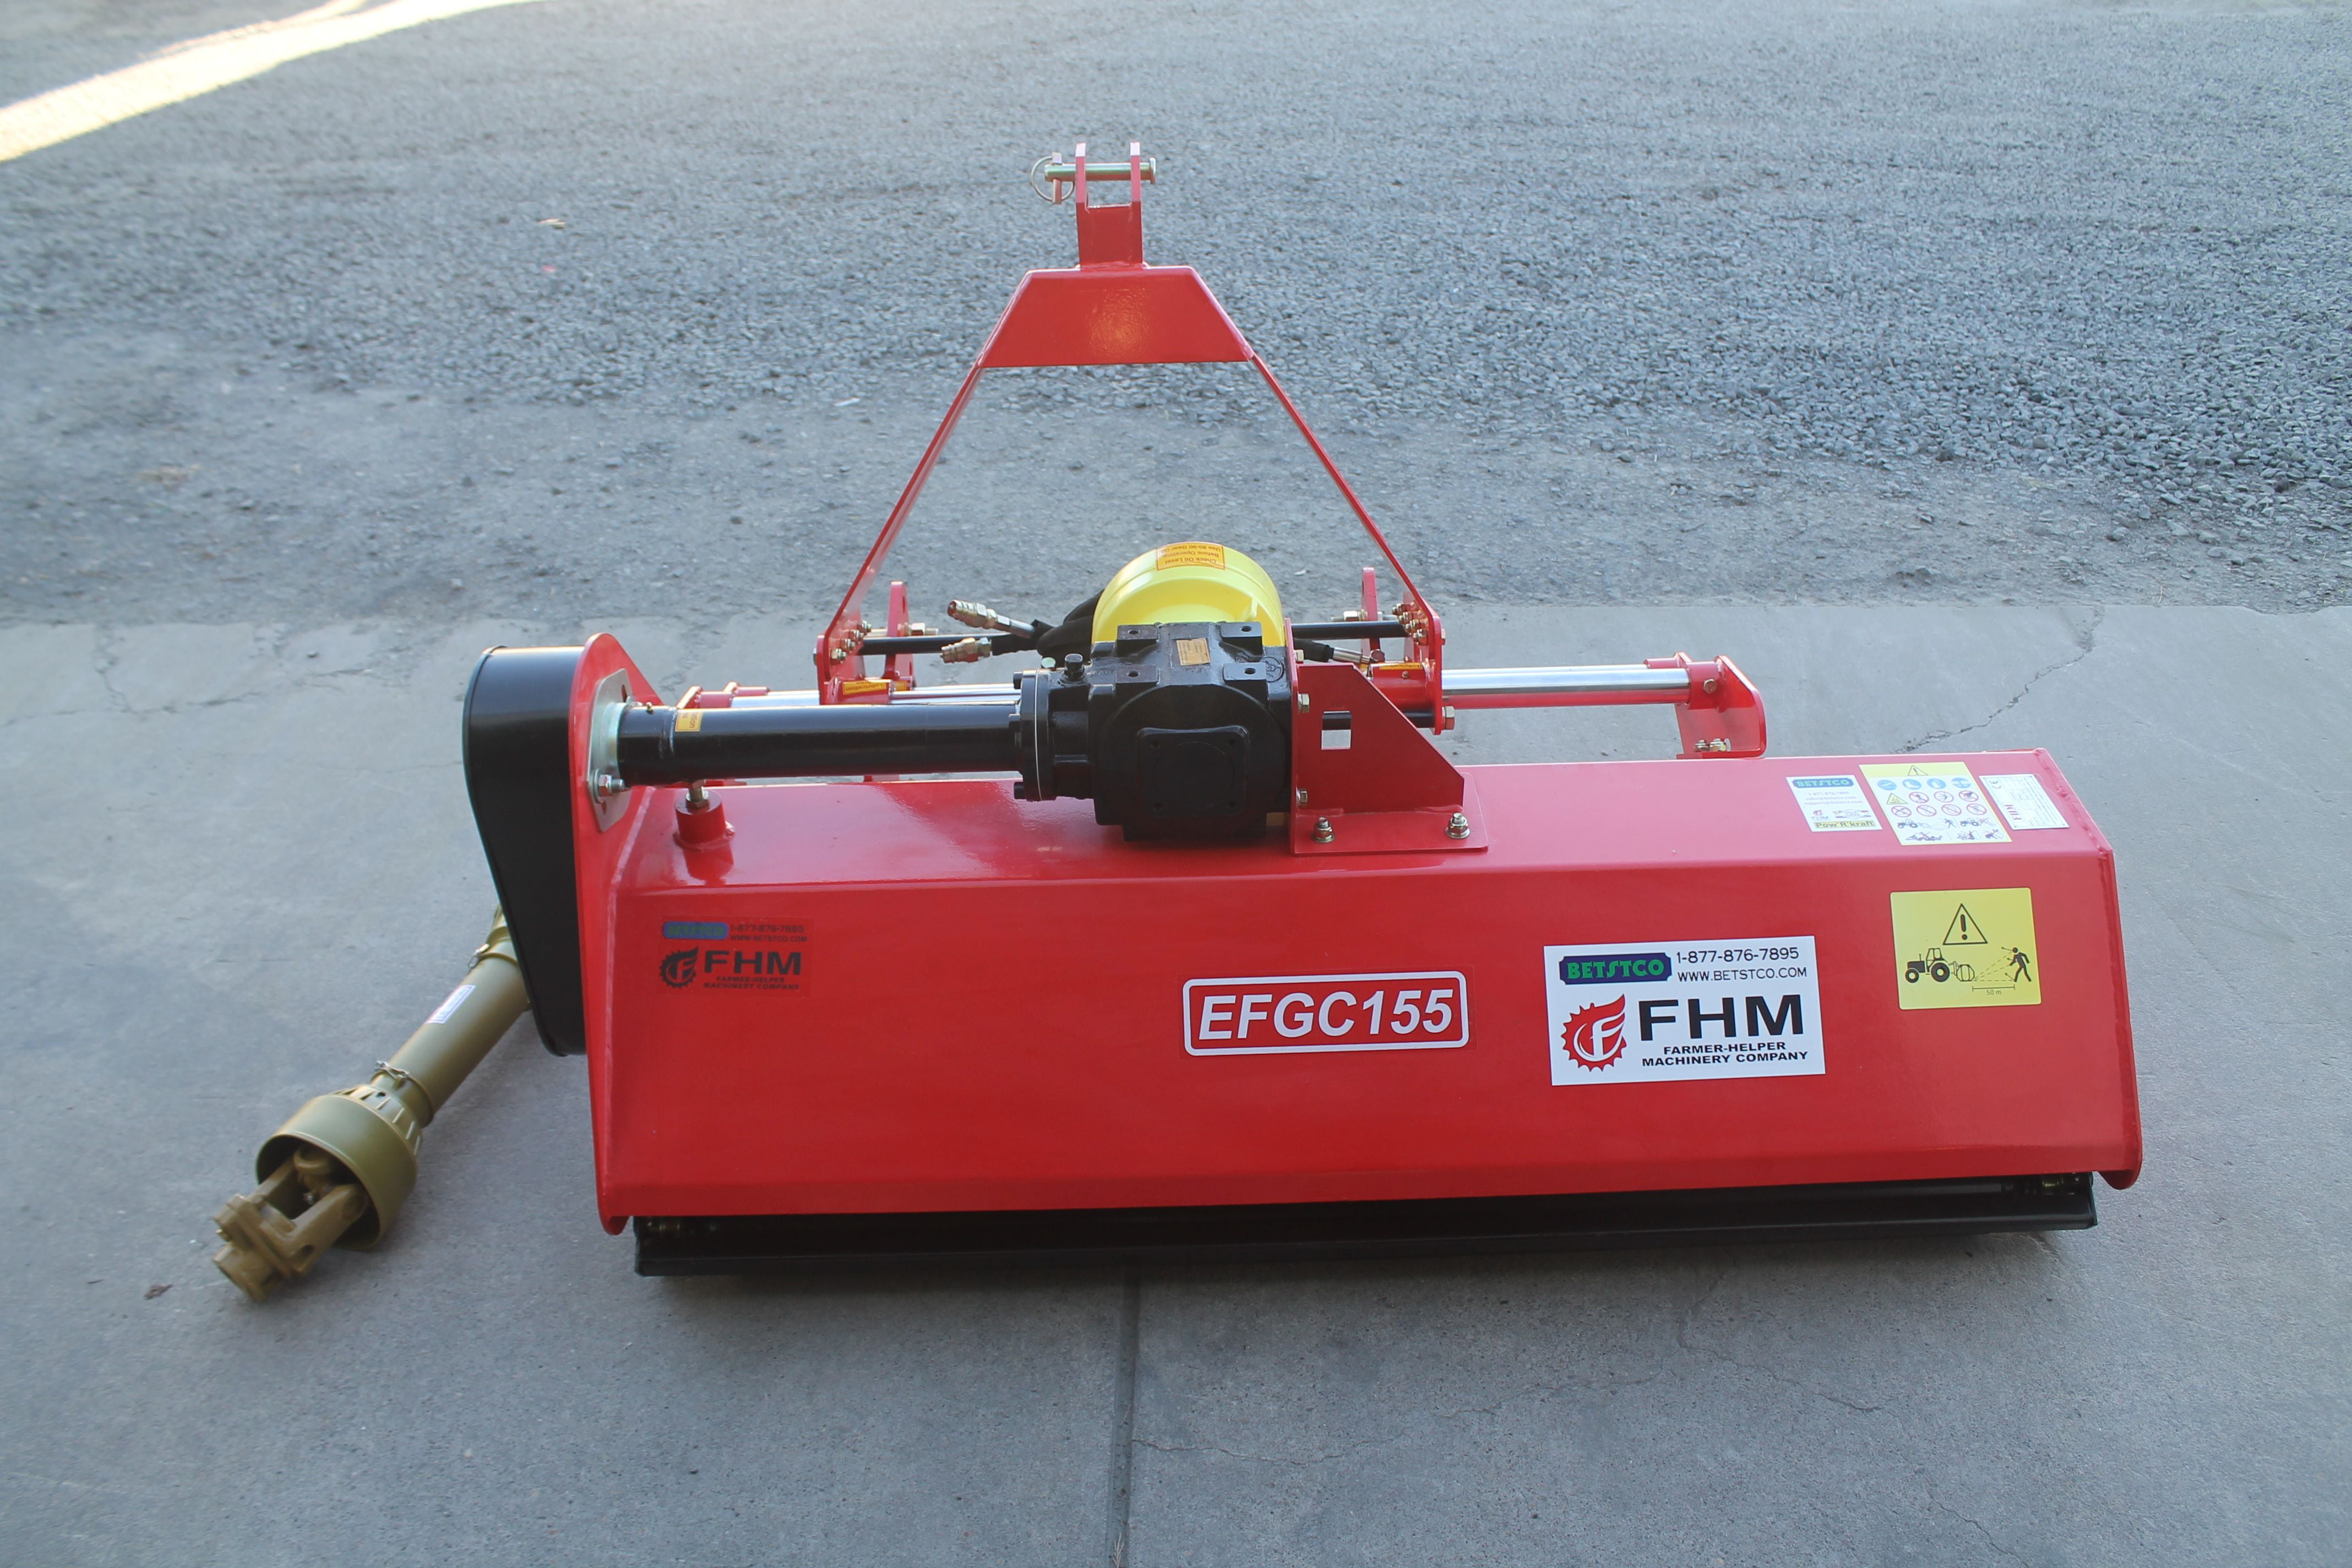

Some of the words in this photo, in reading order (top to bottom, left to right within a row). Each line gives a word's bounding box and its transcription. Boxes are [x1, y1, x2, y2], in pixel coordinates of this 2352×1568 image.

[2005, 804, 2022, 820] FHM
[705, 950, 802, 974] FHM
[1566, 959, 1664, 979] BETSTCO
[1676, 946, 1800, 964] 1-877-876-7895
[1677, 967, 1807, 982] WWW.BETSTCO.COM
[1199, 988, 1453, 1040] EFGC155
[1638, 994, 1804, 1041] FHM
[1642, 1053, 1730, 1067] MACHINERY
[1735, 1050, 1808, 1063] COMPANY
[1663, 1042, 1786, 1055] FARMER-HELPER
